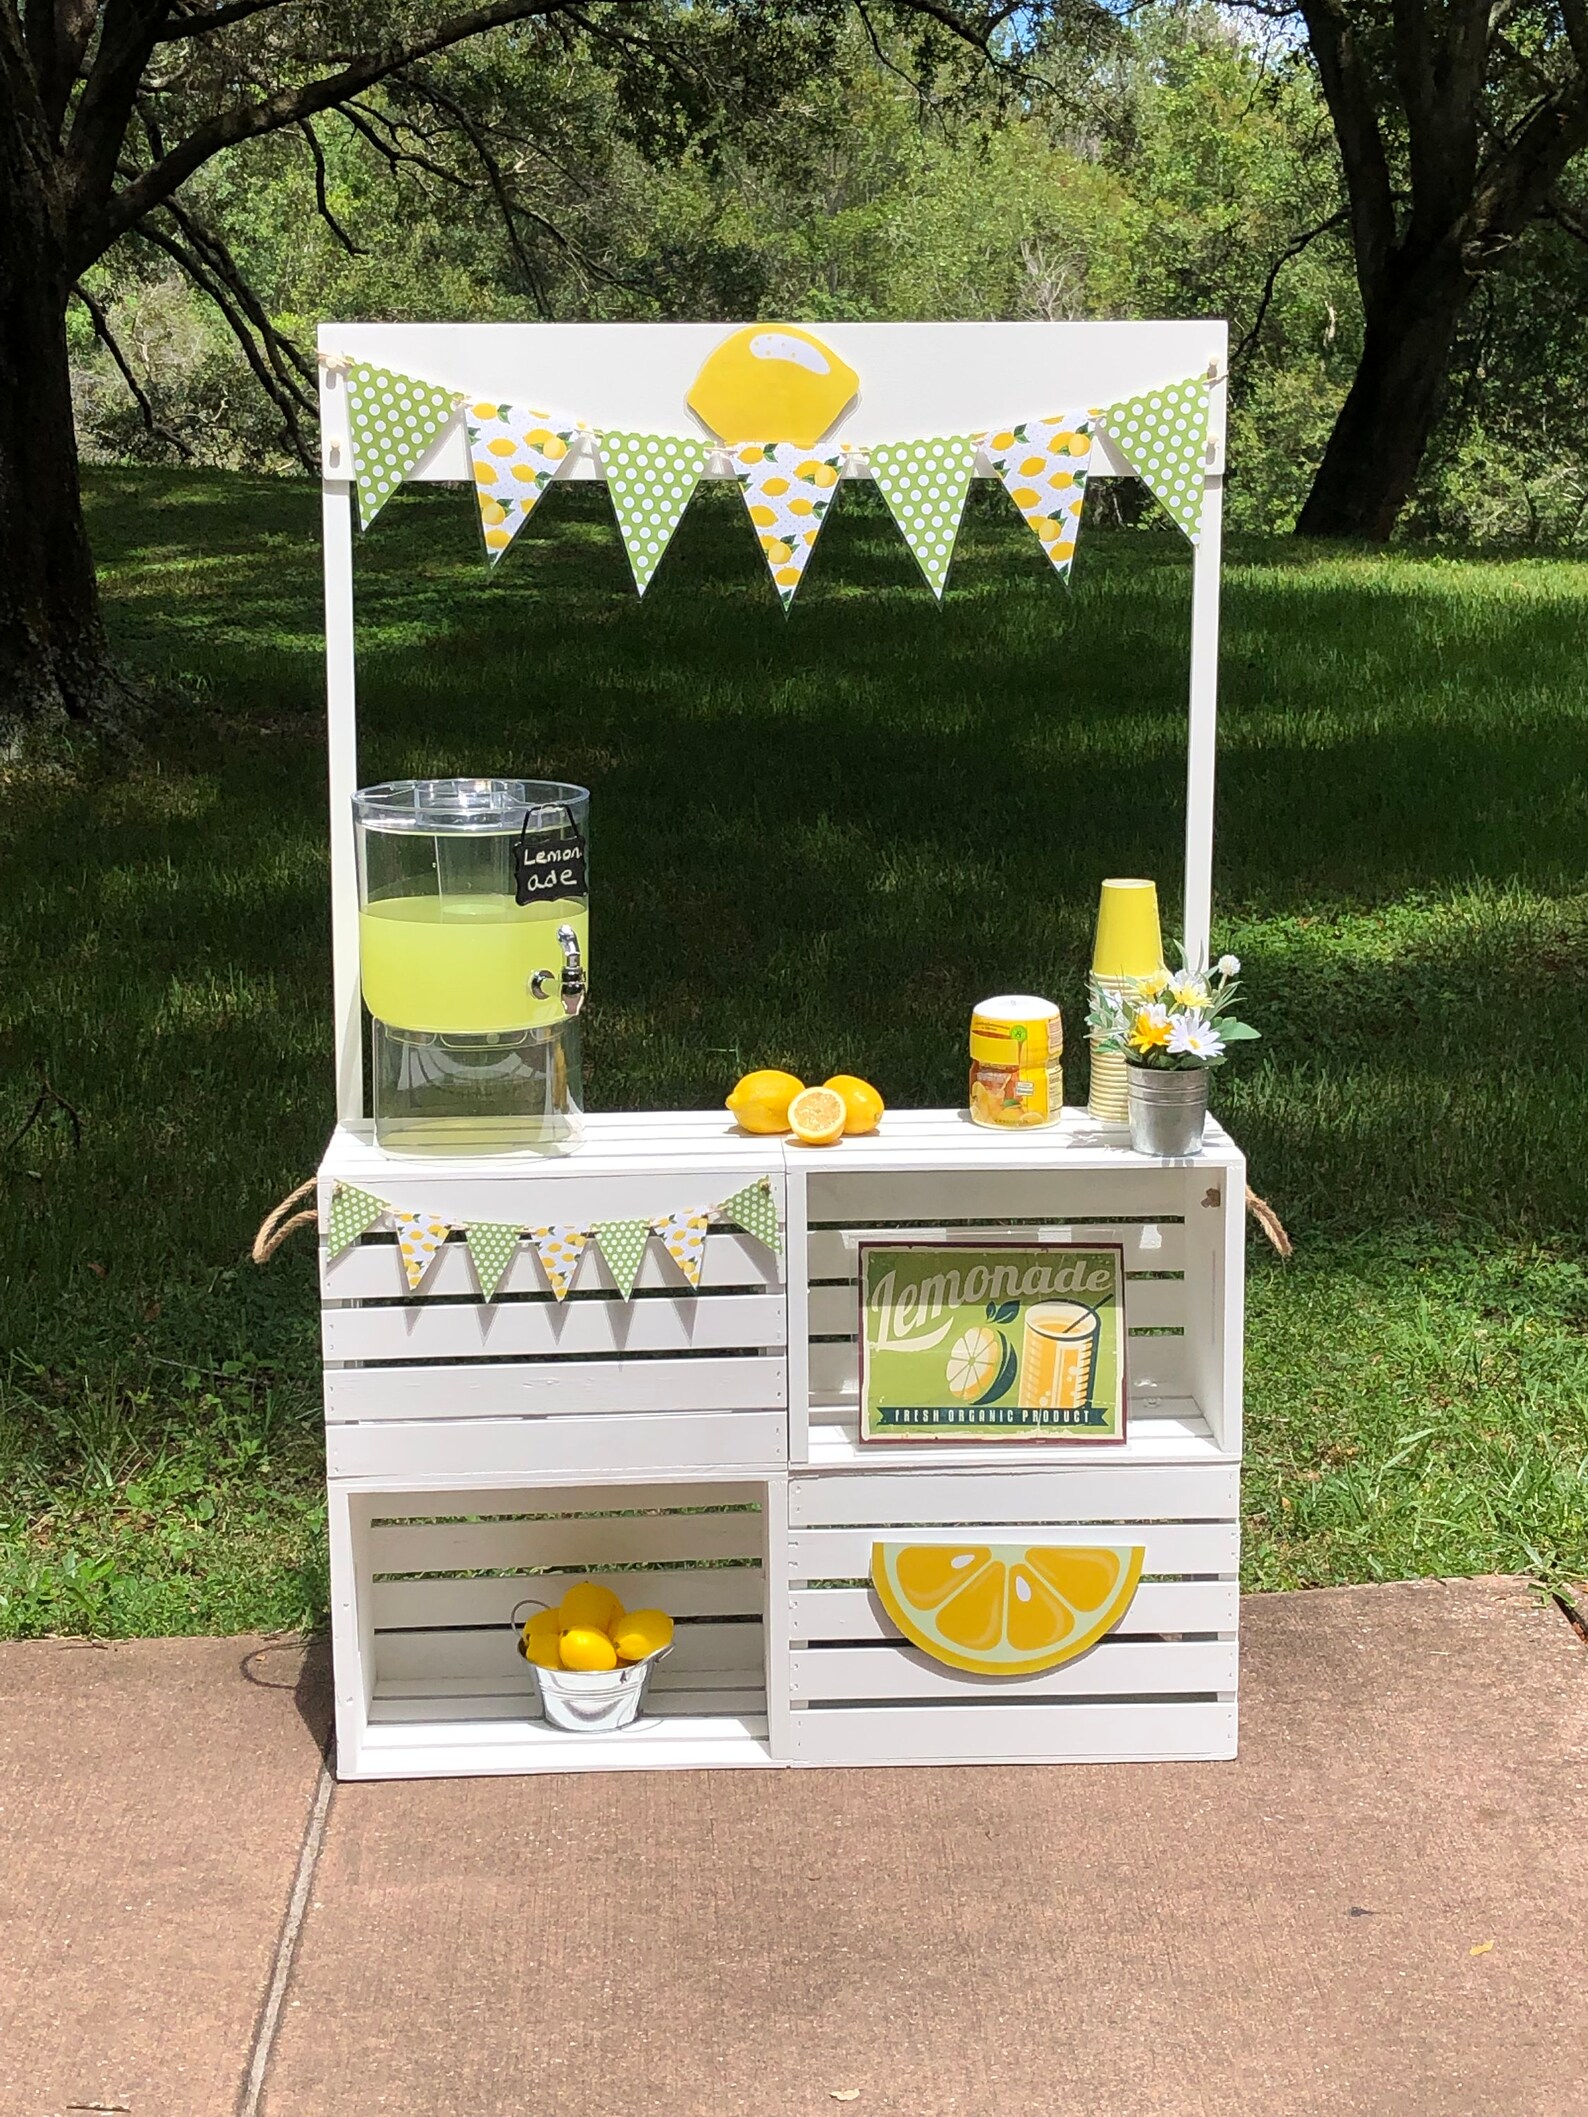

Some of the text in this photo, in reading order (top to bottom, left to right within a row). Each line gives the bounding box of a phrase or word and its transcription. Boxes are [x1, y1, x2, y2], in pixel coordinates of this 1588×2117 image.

[524, 846, 582, 865] Lemon
[527, 869, 577, 891] ade
[870, 1260, 1113, 1351] Lemonade
[895, 1409, 1090, 1423] FRESH ORGANIC PRODUCT
